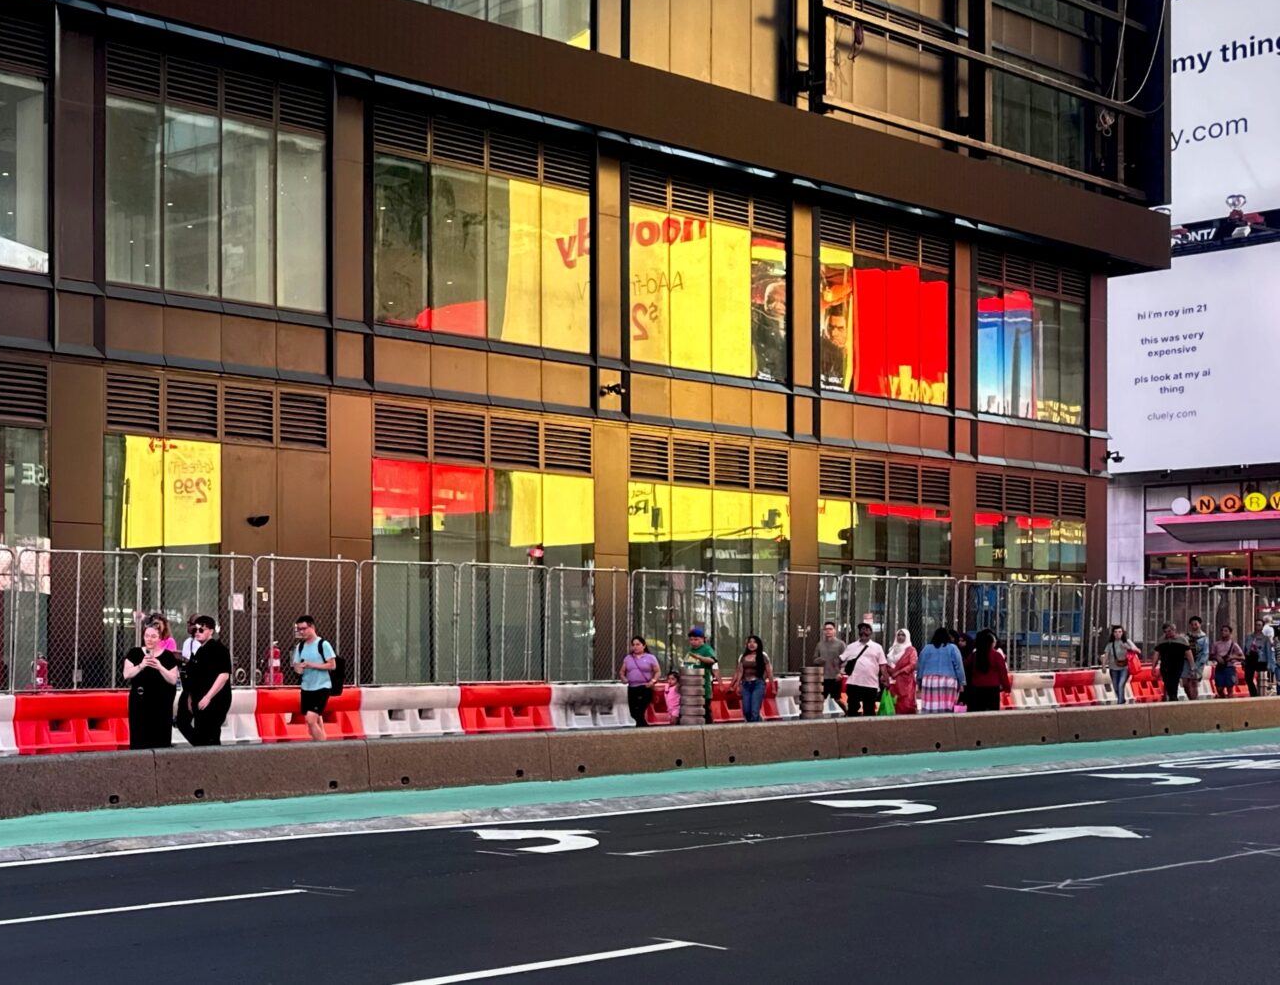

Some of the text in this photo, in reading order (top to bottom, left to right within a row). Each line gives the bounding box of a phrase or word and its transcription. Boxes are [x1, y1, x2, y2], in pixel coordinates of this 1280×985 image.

[1172, 50, 1212, 74] my
[1170, 117, 1248, 152] y.com
[1137, 311, 1146, 321] hi
[1164, 308, 1180, 318] roy
[1182, 306, 1194, 315] im
[1196, 303, 1207, 313] 21
[1140, 331, 1204, 346] this was very
[1147, 345, 1197, 358] expensive
[1134, 368, 1211, 385] pls look at my ai
[1159, 385, 1185, 395] thing
[1199, 498, 1211, 511] N
[1223, 496, 1237, 510] Q
[1249, 496, 1260, 508] R
